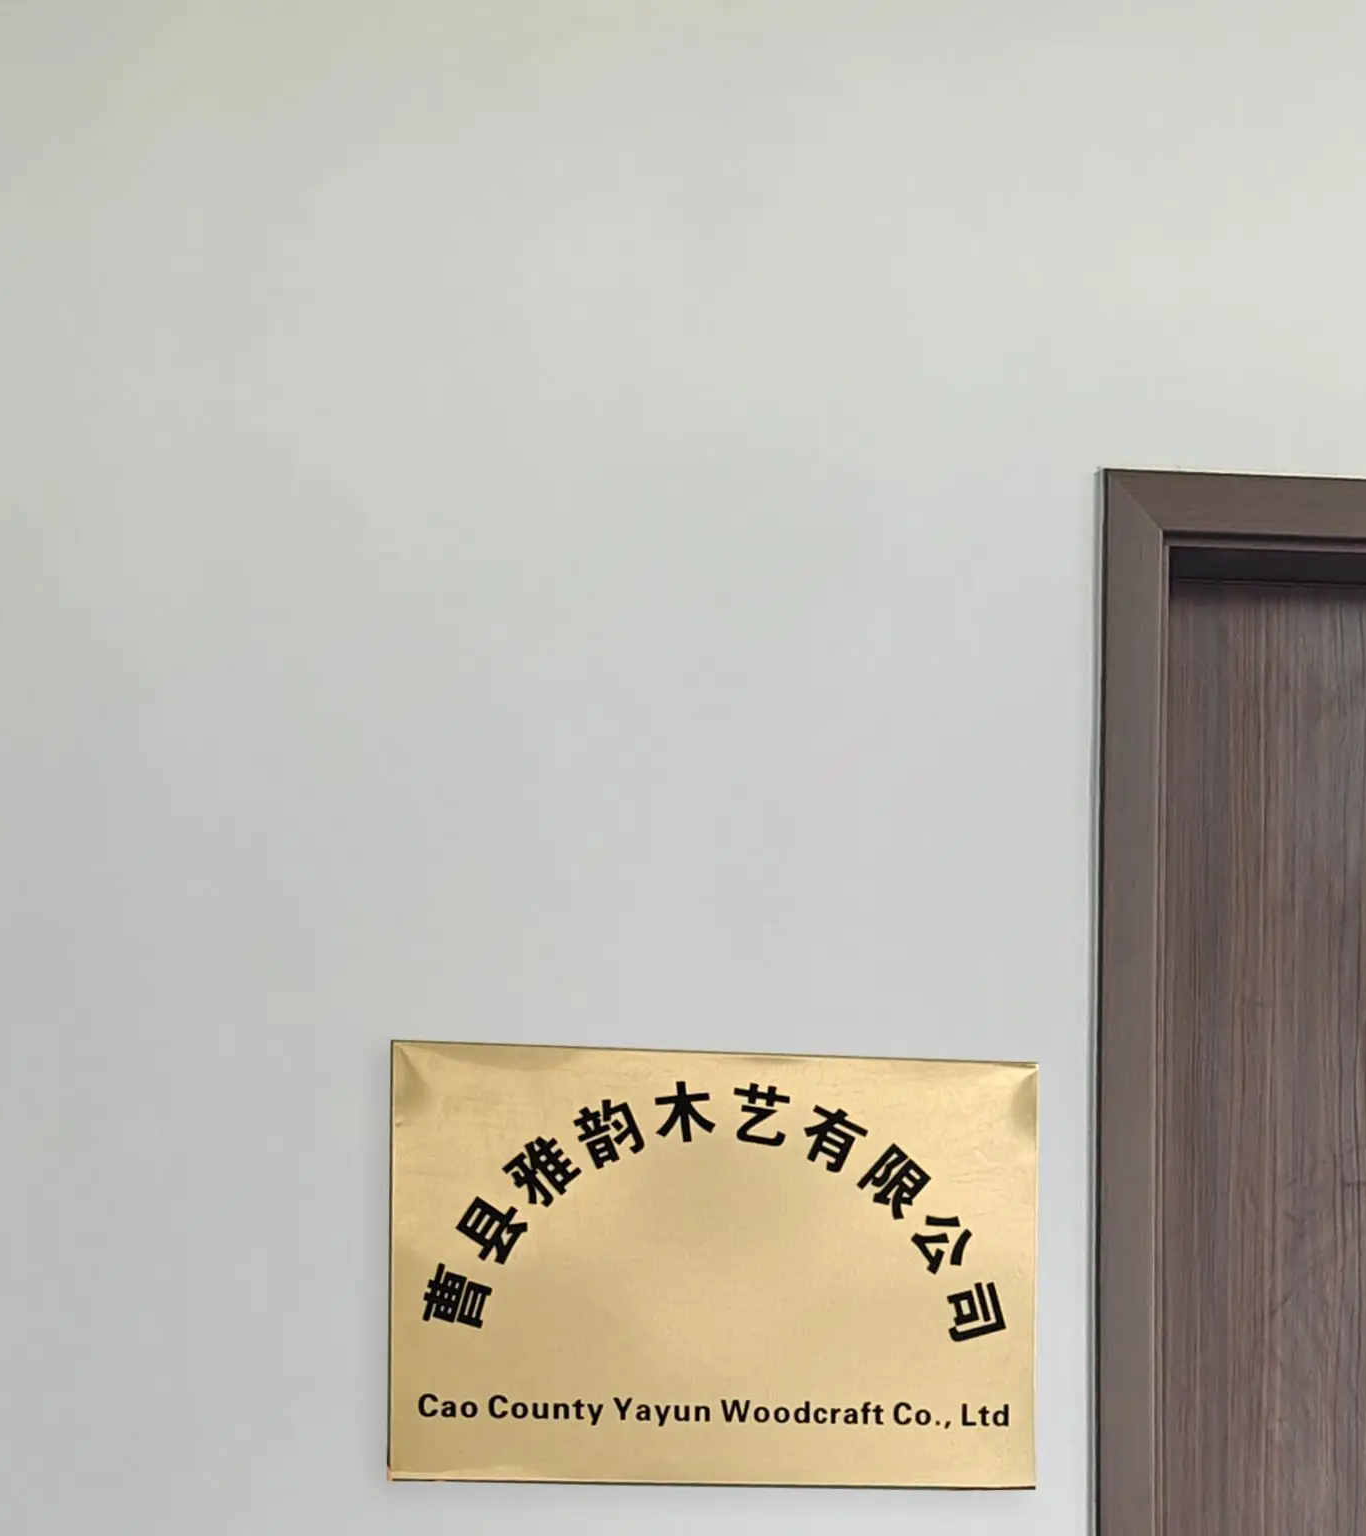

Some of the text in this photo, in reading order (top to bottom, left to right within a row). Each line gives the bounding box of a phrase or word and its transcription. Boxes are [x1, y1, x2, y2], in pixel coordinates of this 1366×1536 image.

[422, 1081, 1006, 1342] 曹县雅韵木艺有限公司
[418, 1394, 1008, 1428] Cao County Yayun Woodcraft Co., Ltd
